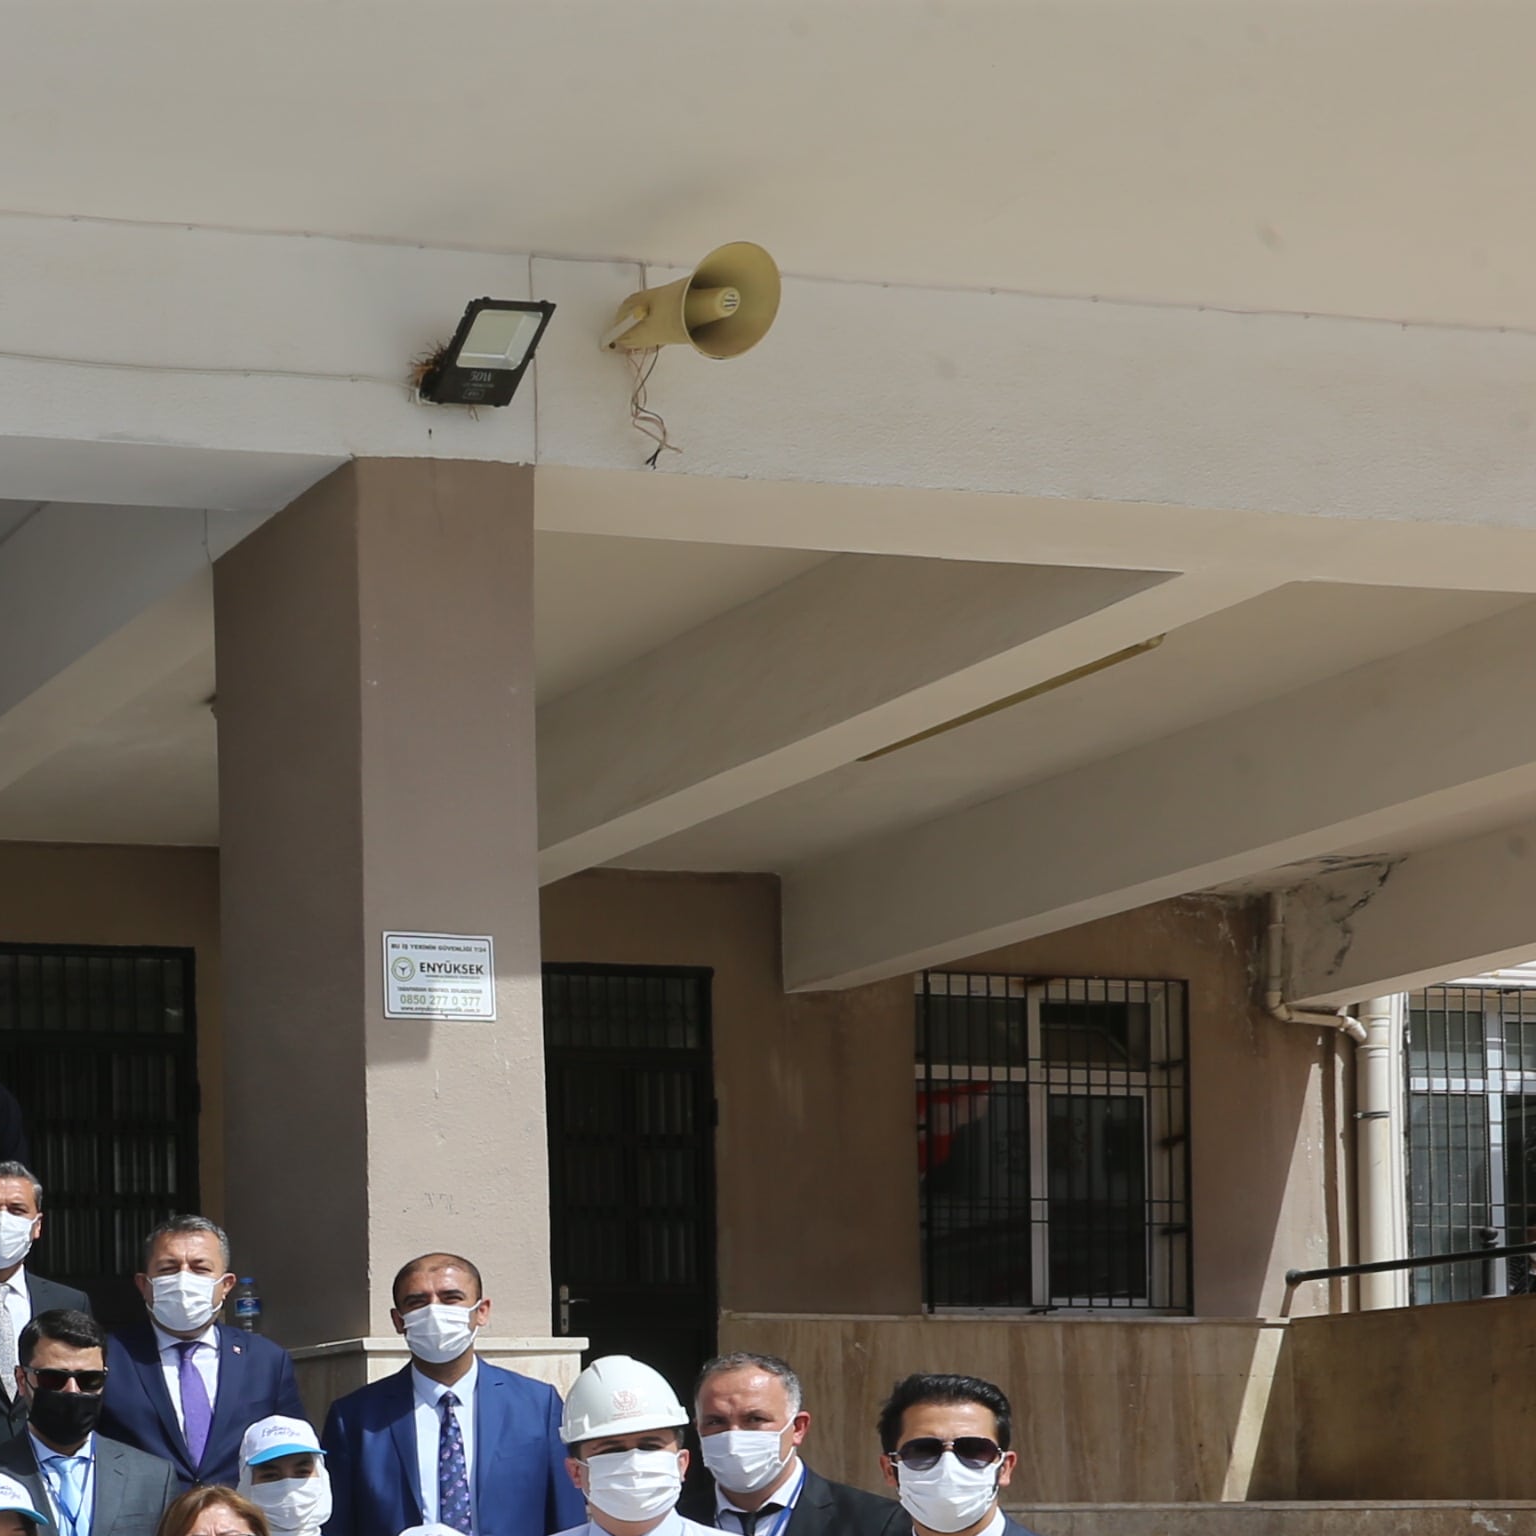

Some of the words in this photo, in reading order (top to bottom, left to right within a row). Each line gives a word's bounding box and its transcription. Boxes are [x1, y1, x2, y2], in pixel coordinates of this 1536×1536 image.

[419, 960, 484, 975] ENYÜKSEK
[400, 994, 426, 1006] 0850
[429, 995, 448, 1006] 277
[452, 996, 458, 1006] 0
[462, 997, 480, 1007] 377
